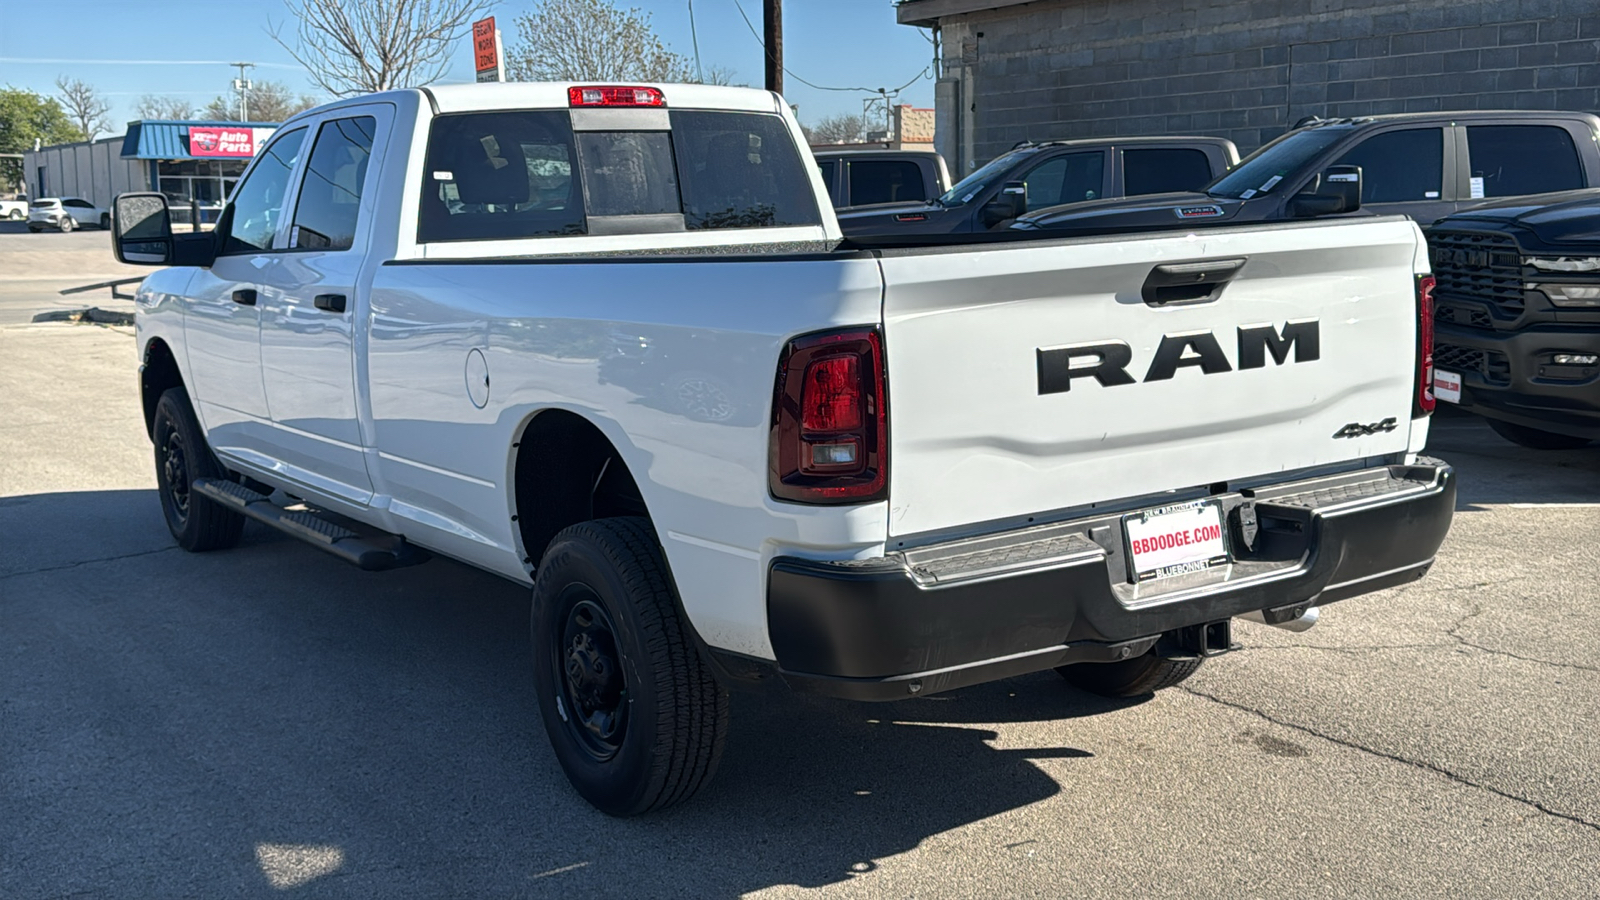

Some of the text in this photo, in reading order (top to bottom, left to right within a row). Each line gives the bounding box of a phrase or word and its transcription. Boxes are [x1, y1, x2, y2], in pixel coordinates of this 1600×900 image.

[476, 23, 492, 37] BEGIN
[478, 38, 493, 51] WORK
[479, 52, 494, 67] ZONE
[219, 131, 248, 142] Auto
[218, 142, 251, 152] Parts
[1036, 317, 1321, 396] RAM
[1132, 524, 1221, 555] BBDODGE.COM
[1156, 559, 1210, 578] BLUEBONNET
